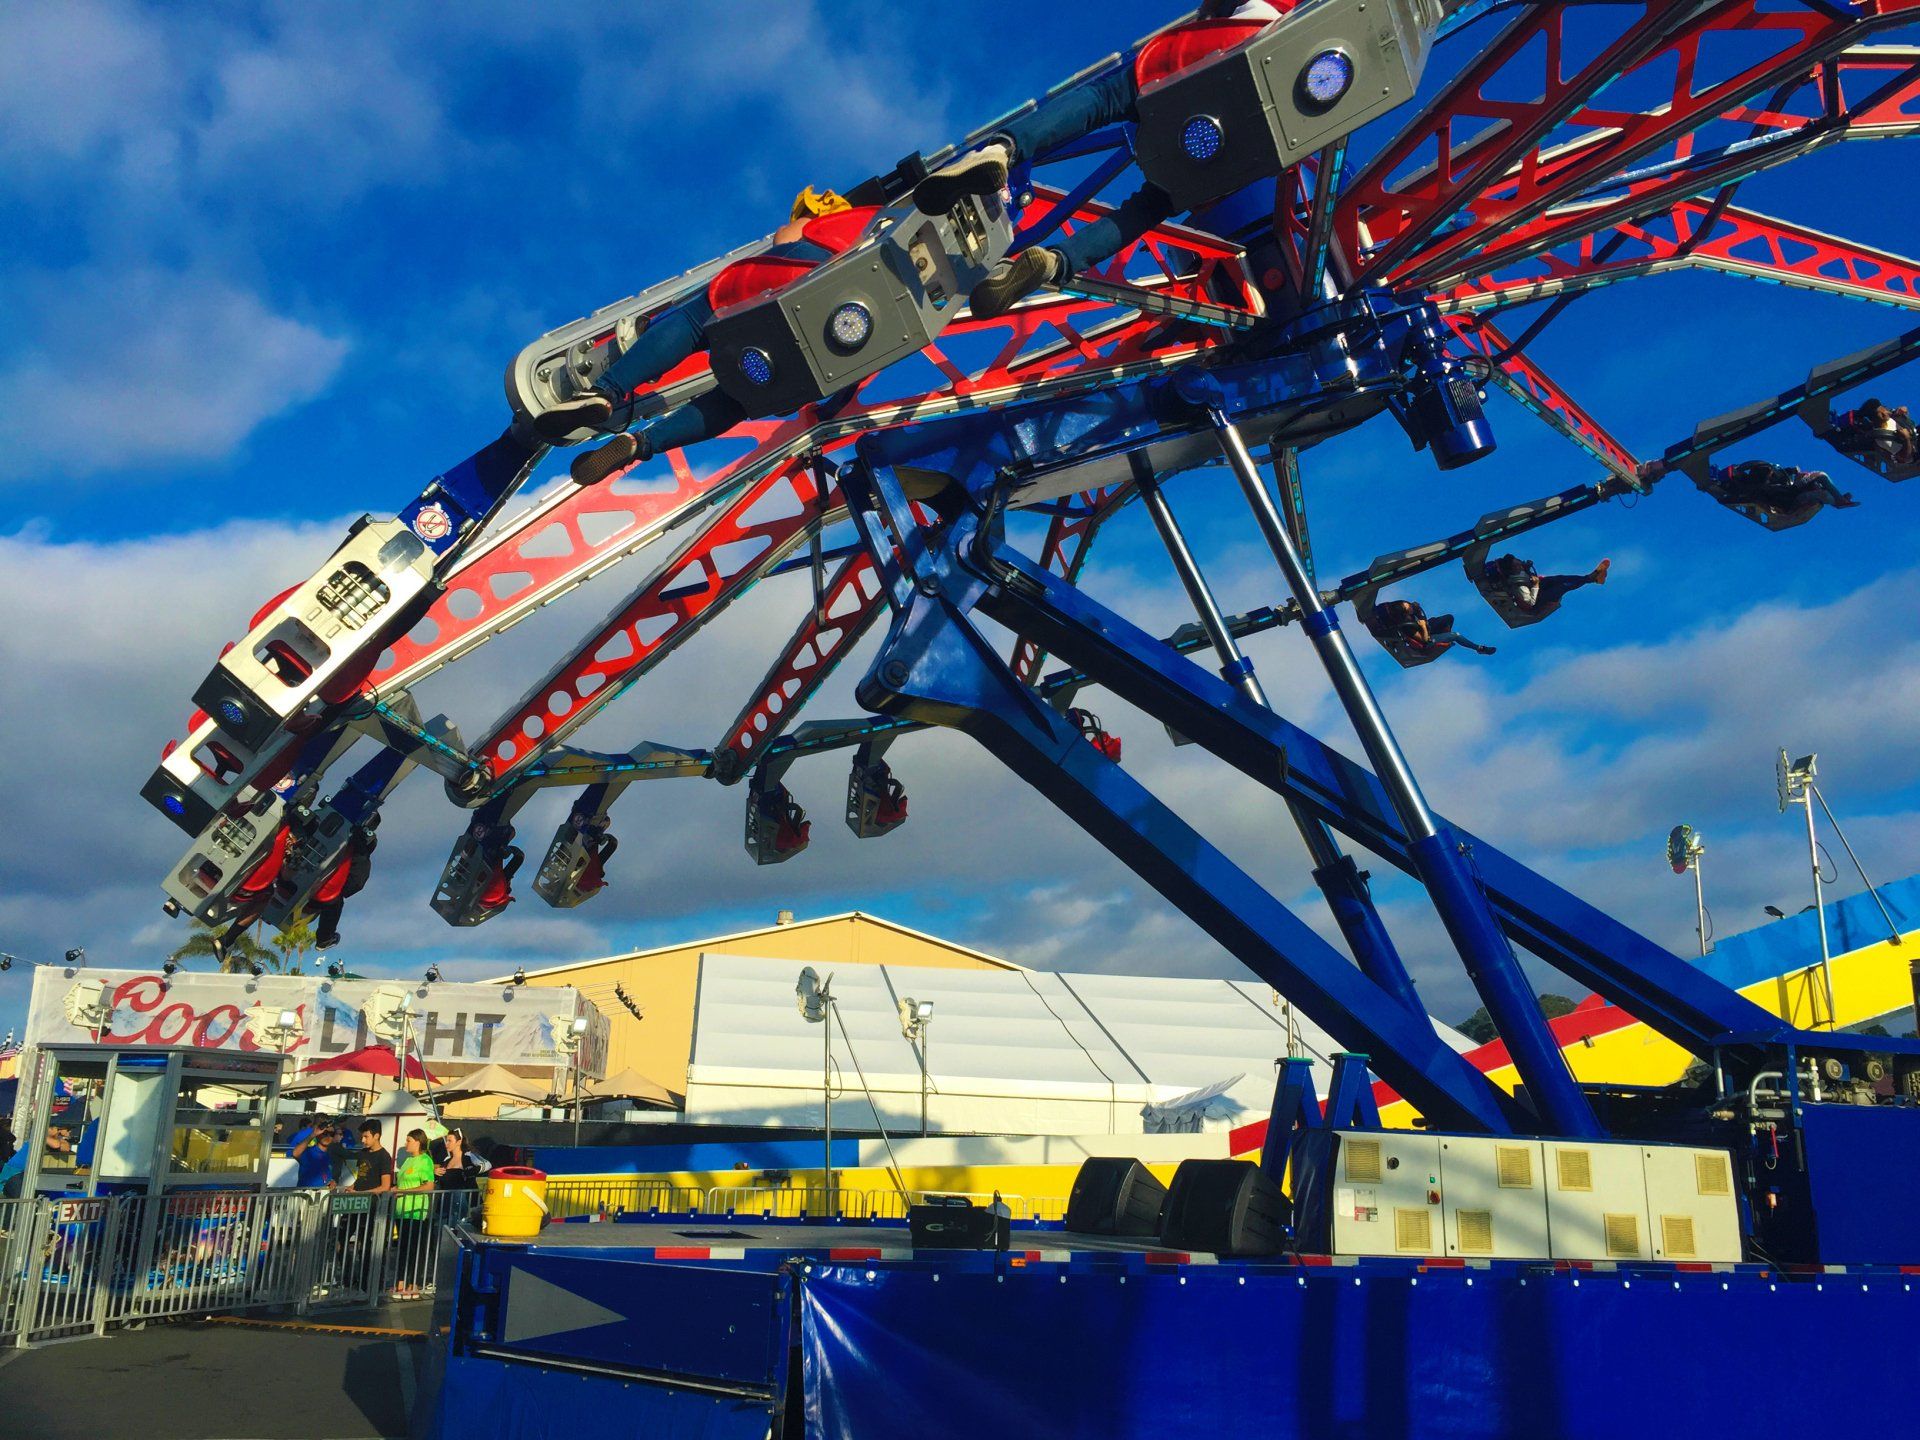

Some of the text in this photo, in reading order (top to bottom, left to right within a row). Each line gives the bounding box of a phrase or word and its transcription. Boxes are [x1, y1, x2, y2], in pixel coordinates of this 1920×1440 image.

[319, 1006, 507, 1059] LIHT
[59, 1202, 101, 1222] EXIT
[332, 1196, 369, 1211] ENTER
